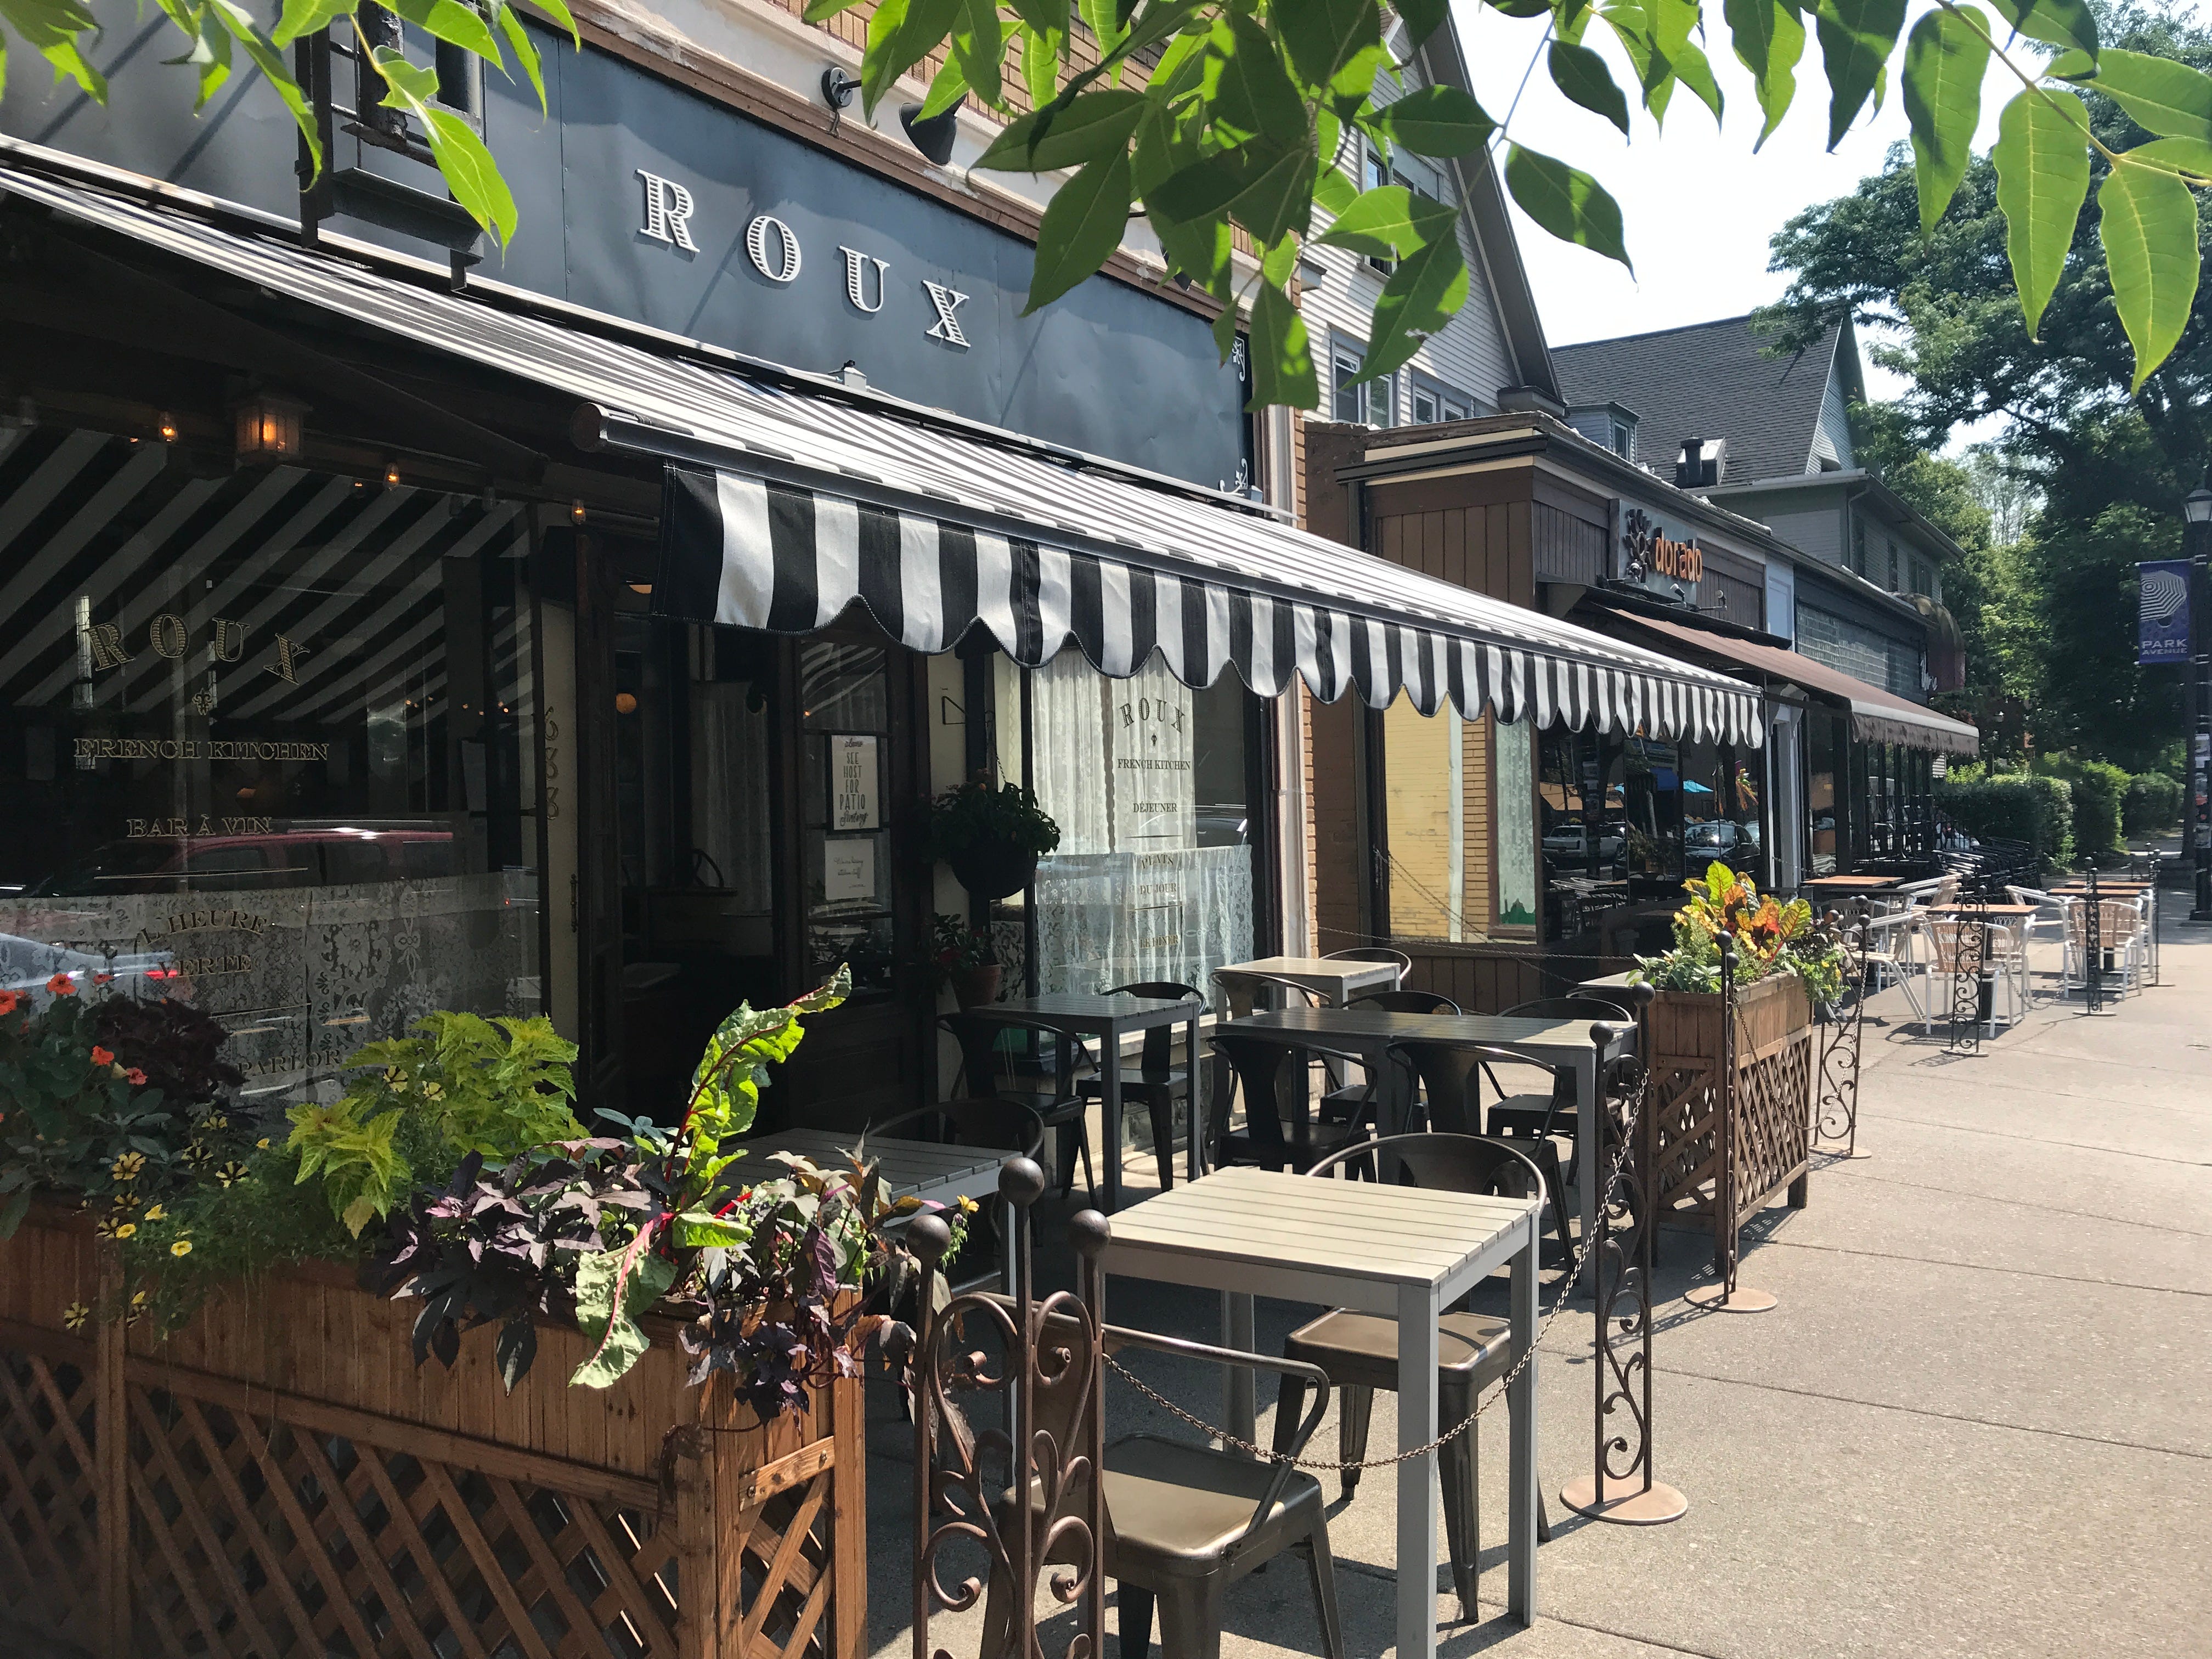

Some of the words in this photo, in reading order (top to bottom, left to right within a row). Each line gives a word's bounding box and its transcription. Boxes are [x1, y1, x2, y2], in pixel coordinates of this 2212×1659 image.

[635, 167, 970, 347] ROUX
[1655, 527, 1702, 583] dorado
[82, 613, 310, 685] ROUX
[2141, 639, 2187, 648] PARK
[1119, 697, 1186, 733] ROUX
[74, 738, 201, 759] FRENCH
[207, 741, 329, 760] KITCHEN
[847, 752, 859, 765] SEE
[1118, 759, 1153, 769] FRENCH
[1154, 760, 1190, 770] KITCHEN
[843, 765, 862, 779] HOST
[845, 779, 860, 794] FOR
[839, 794, 866, 810] PATIO
[1133, 801, 1177, 812] DÉJEUNER
[127, 817, 190, 838] BAR
[196, 814, 216, 837] À
[222, 816, 272, 836] VIN
[1141, 854, 1175, 870] PLATS
[1139, 884, 1152, 895] DU
[1154, 882, 1177, 894] JOUR
[1139, 938, 1150, 948] LE
[157, 954, 252, 978] VERTE
[236, 1048, 342, 1076] PARLOR
